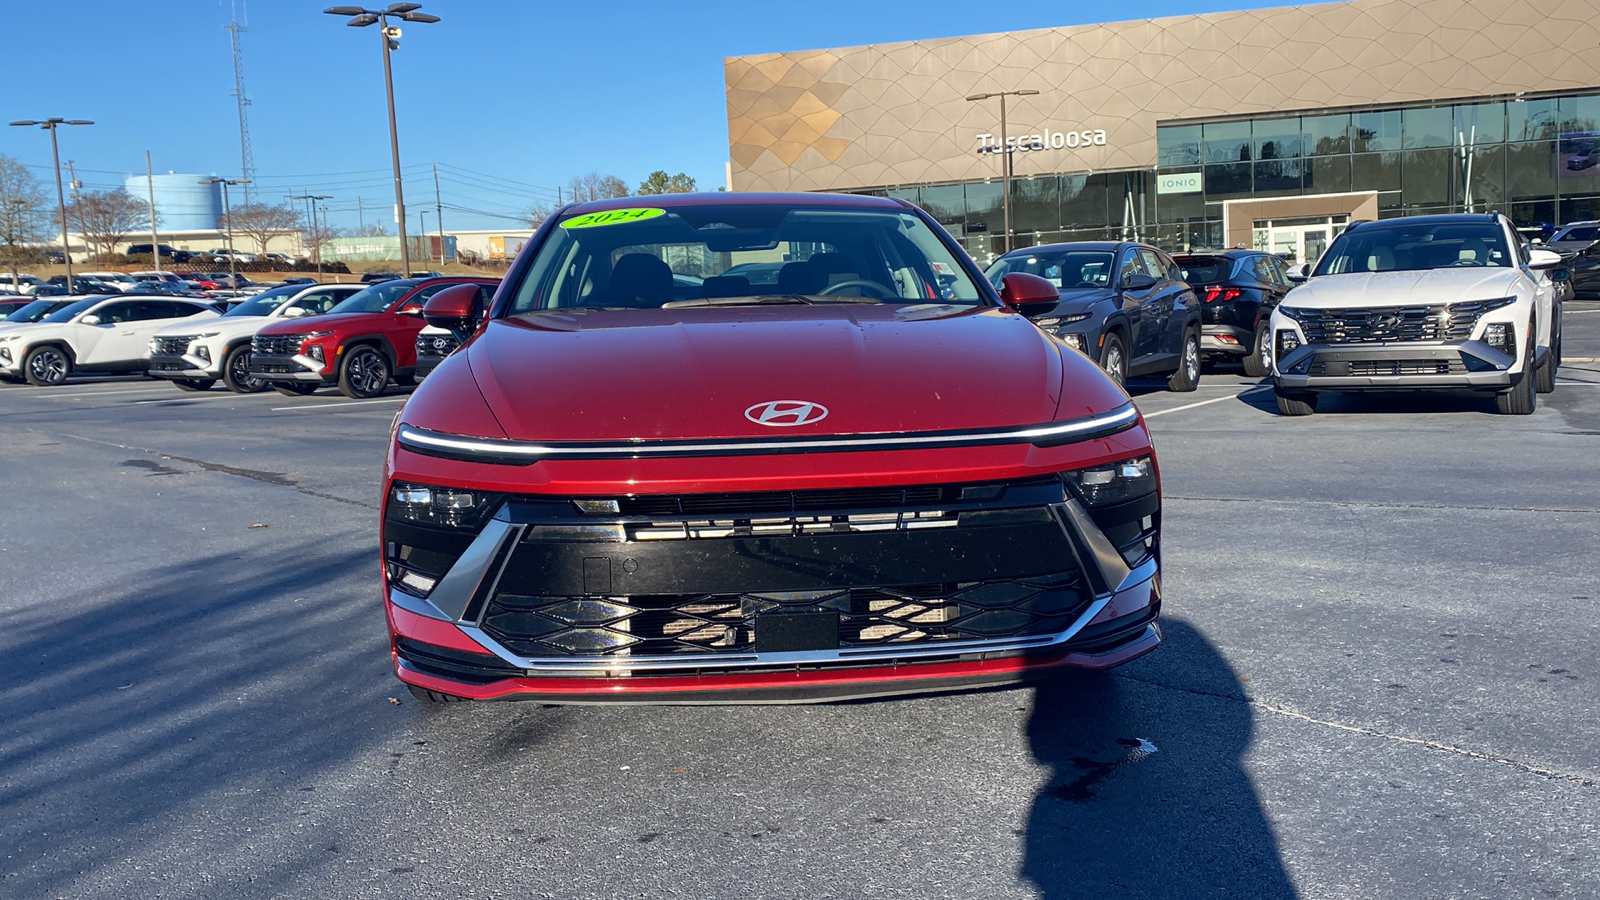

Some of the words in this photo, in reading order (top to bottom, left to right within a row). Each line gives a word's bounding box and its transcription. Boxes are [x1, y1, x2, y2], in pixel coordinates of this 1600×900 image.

[976, 128, 1106, 155] Tuscaloosa
[1162, 179, 1196, 188] IONIQ
[575, 209, 649, 226] 2024
